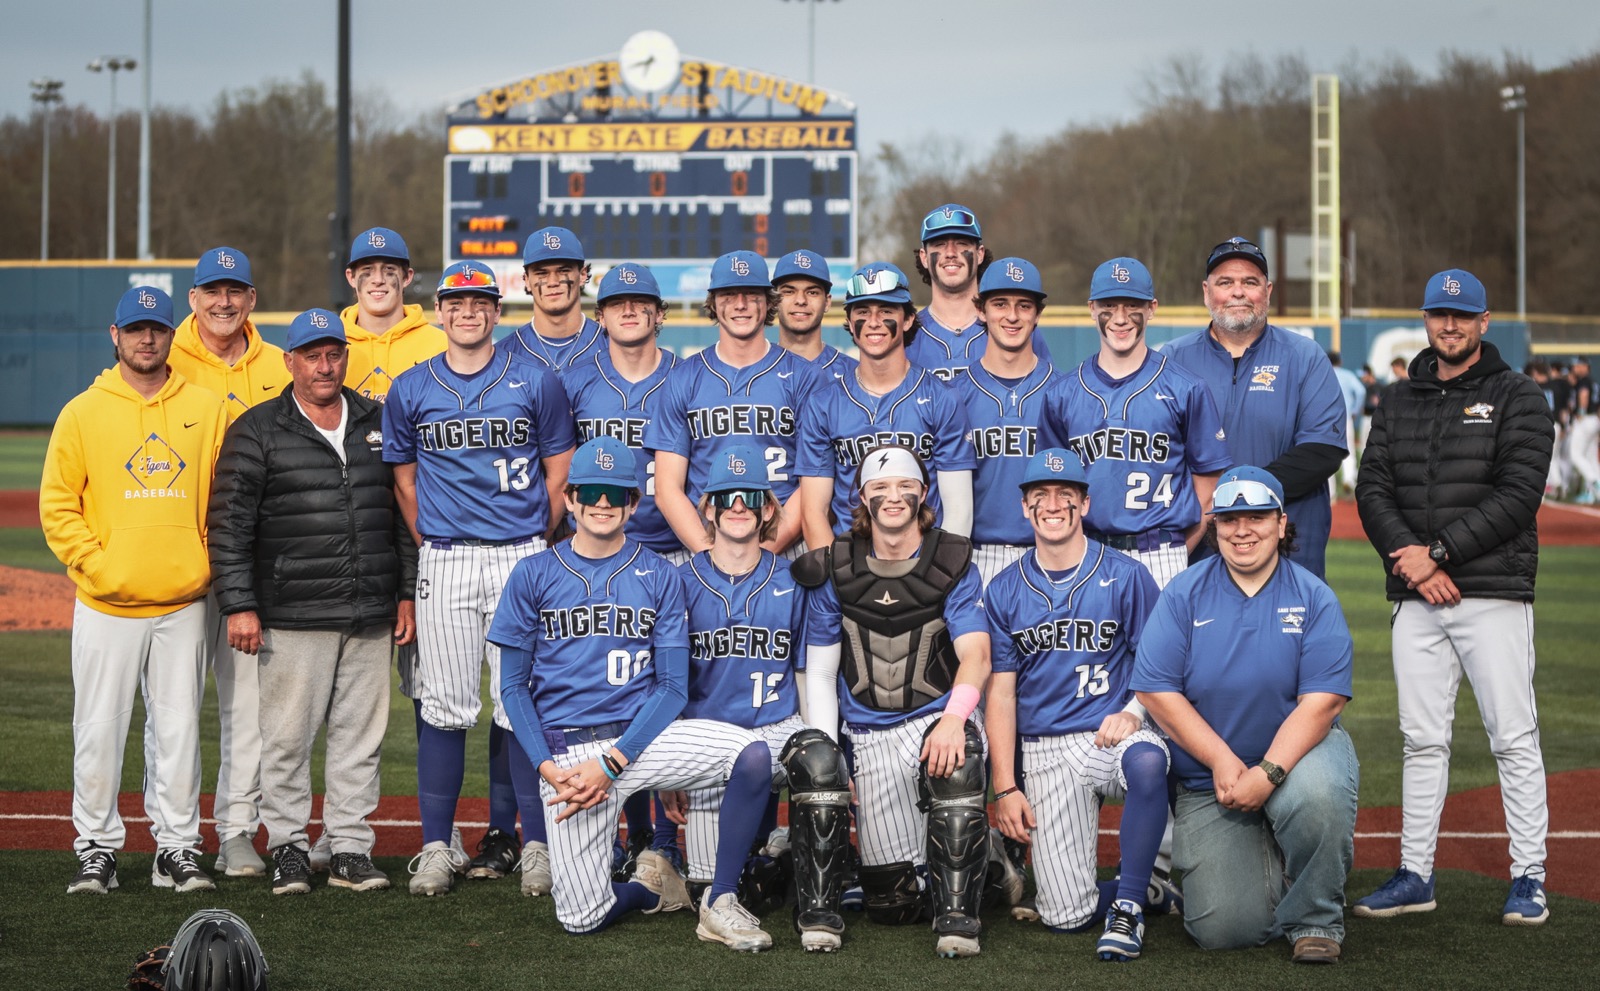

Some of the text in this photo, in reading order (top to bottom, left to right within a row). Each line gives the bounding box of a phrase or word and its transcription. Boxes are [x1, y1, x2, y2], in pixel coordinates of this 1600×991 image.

[476, 61, 828, 119] SCHOONOVER STADIUM
[582, 93, 719, 112] MURAL FIELD
[494, 126, 852, 149] KENT STATE BASEBALL
[558, 155, 594, 173] BALL
[568, 172, 585, 197] 0
[650, 171, 667, 197] 0
[731, 171, 748, 197] 0
[368, 231, 386, 249] LC
[543, 232, 561, 250] LC
[218, 251, 235, 269] LC
[731, 256, 749, 276] LC
[794, 252, 811, 270] LC
[619, 267, 637, 285] LC
[1006, 262, 1024, 282] LC
[1112, 263, 1129, 283] LC
[1443, 275, 1461, 296] LC
[138, 290, 156, 309] LC
[310, 312, 328, 329] LC
[416, 417, 531, 451] TIGERS
[577, 418, 652, 448] TIGE
[687, 404, 796, 441] TIGERS
[973, 425, 1038, 459] IGER
[1069, 426, 1170, 467] TIGERS
[595, 448, 614, 471] LC
[728, 454, 746, 476] LC
[1045, 452, 1064, 473] LC
[493, 457, 531, 492] 13
[125, 488, 187, 499] BASEBALL
[1125, 471, 1174, 510] 24
[540, 604, 656, 641] TIGERS
[688, 625, 792, 661] TIGERS
[1011, 618, 1119, 656] TIGERS
[1075, 663, 1110, 698] 15
